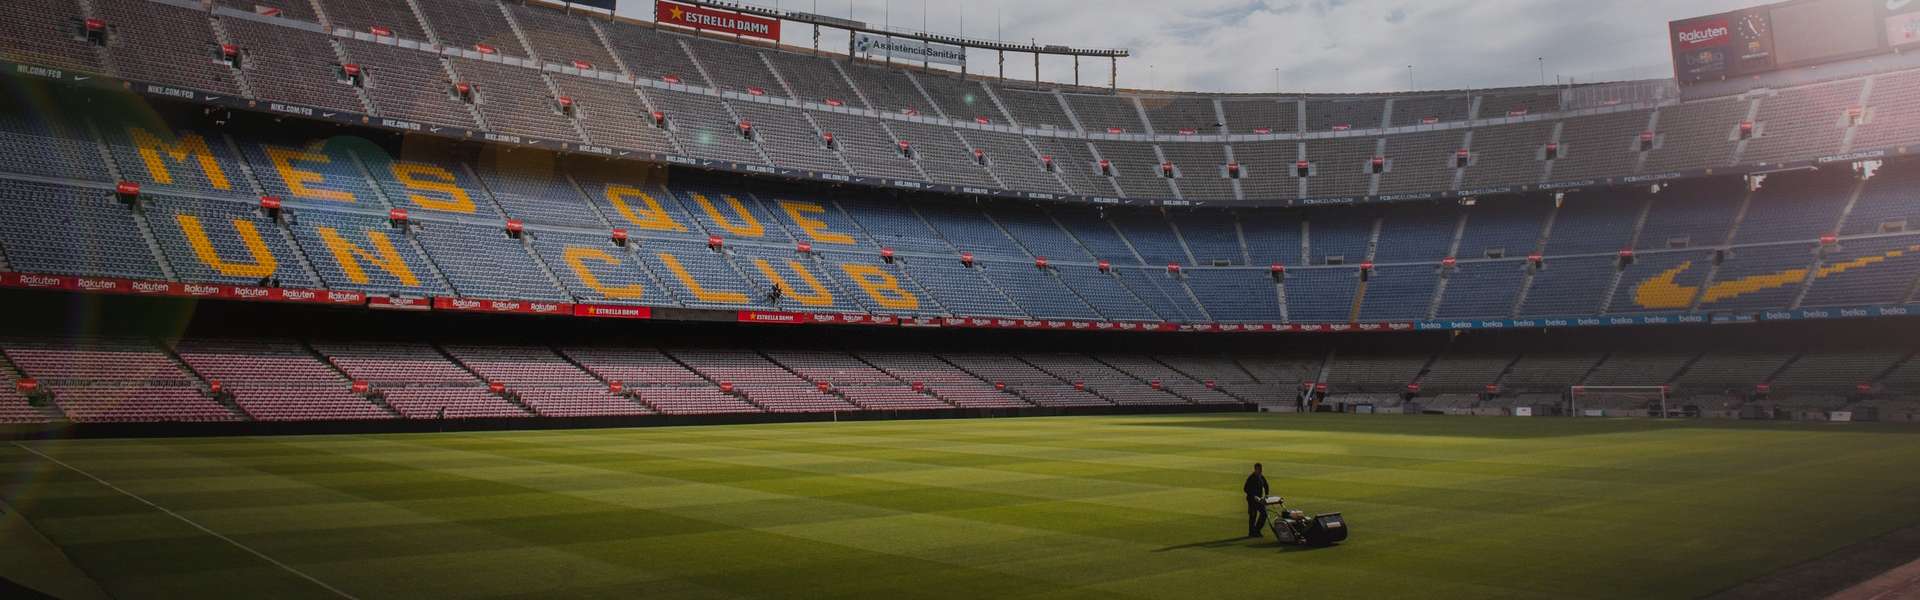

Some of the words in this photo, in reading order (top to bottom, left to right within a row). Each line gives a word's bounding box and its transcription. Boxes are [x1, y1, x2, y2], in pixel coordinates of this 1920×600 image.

[685, 11, 735, 30] ESTRELLA
[736, 20, 768, 34] DAMM
[1679, 26, 1727, 43] Rakuten
[148, 85, 194, 99] NIKE.COM/FCB
[271, 103, 312, 116] NIKE.COM/FCB
[607, 184, 857, 244] QUE
[176, 214, 421, 286] UN
[563, 246, 919, 310] CLUB
[20, 275, 60, 286] Rakuten
[78, 279, 116, 289] Rakuten
[132, 282, 168, 293] Rakuten
[184, 284, 219, 295] Rakuten
[235, 287, 268, 298] Rakuten
[283, 290, 315, 300] Rakuten
[328, 292, 359, 302] Rakuten
[453, 300, 480, 309] Rakuten
[492, 301, 519, 310] Rakuten
[530, 302, 557, 312] Rakuten
[1766, 311, 1791, 320] beko
[1803, 310, 1828, 319] beko
[1841, 309, 1867, 317] beko
[1880, 306, 1907, 315] beko
[1421, 321, 1440, 329] beko
[1482, 320, 1503, 328] beko
[1610, 317, 1632, 325] beko
[1644, 316, 1667, 324] beko
